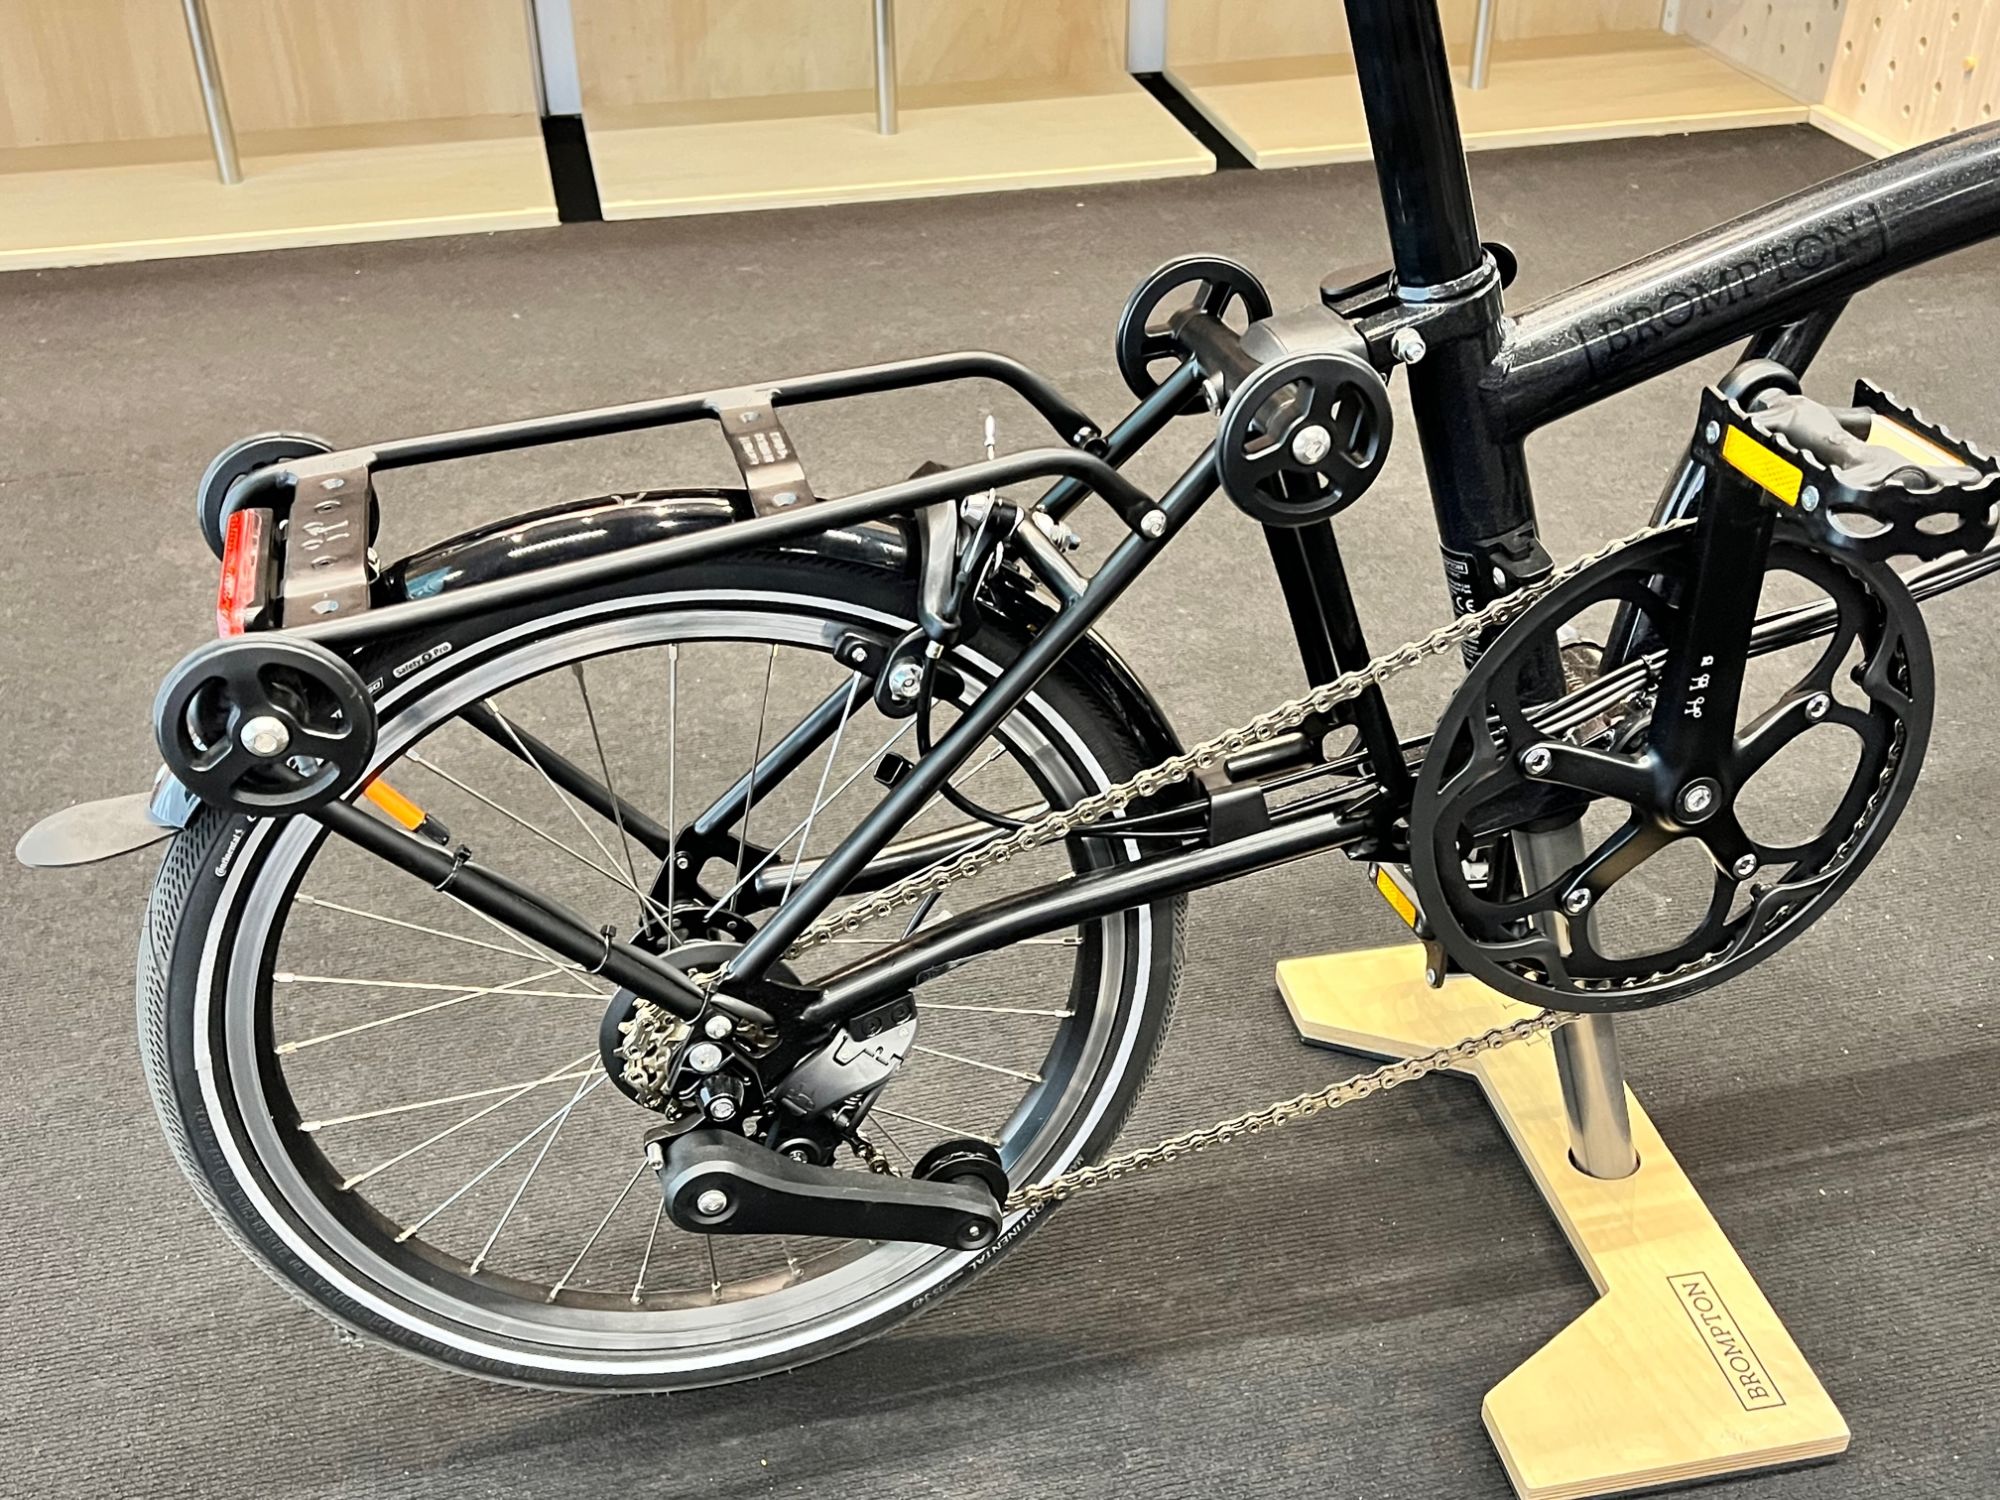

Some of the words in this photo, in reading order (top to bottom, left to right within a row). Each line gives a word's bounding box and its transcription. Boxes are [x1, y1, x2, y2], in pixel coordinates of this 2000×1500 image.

[1601, 212, 1863, 357] BROMPTON
[396, 660, 420, 676] Safety
[1682, 1282, 1770, 1400] BROMPTON
